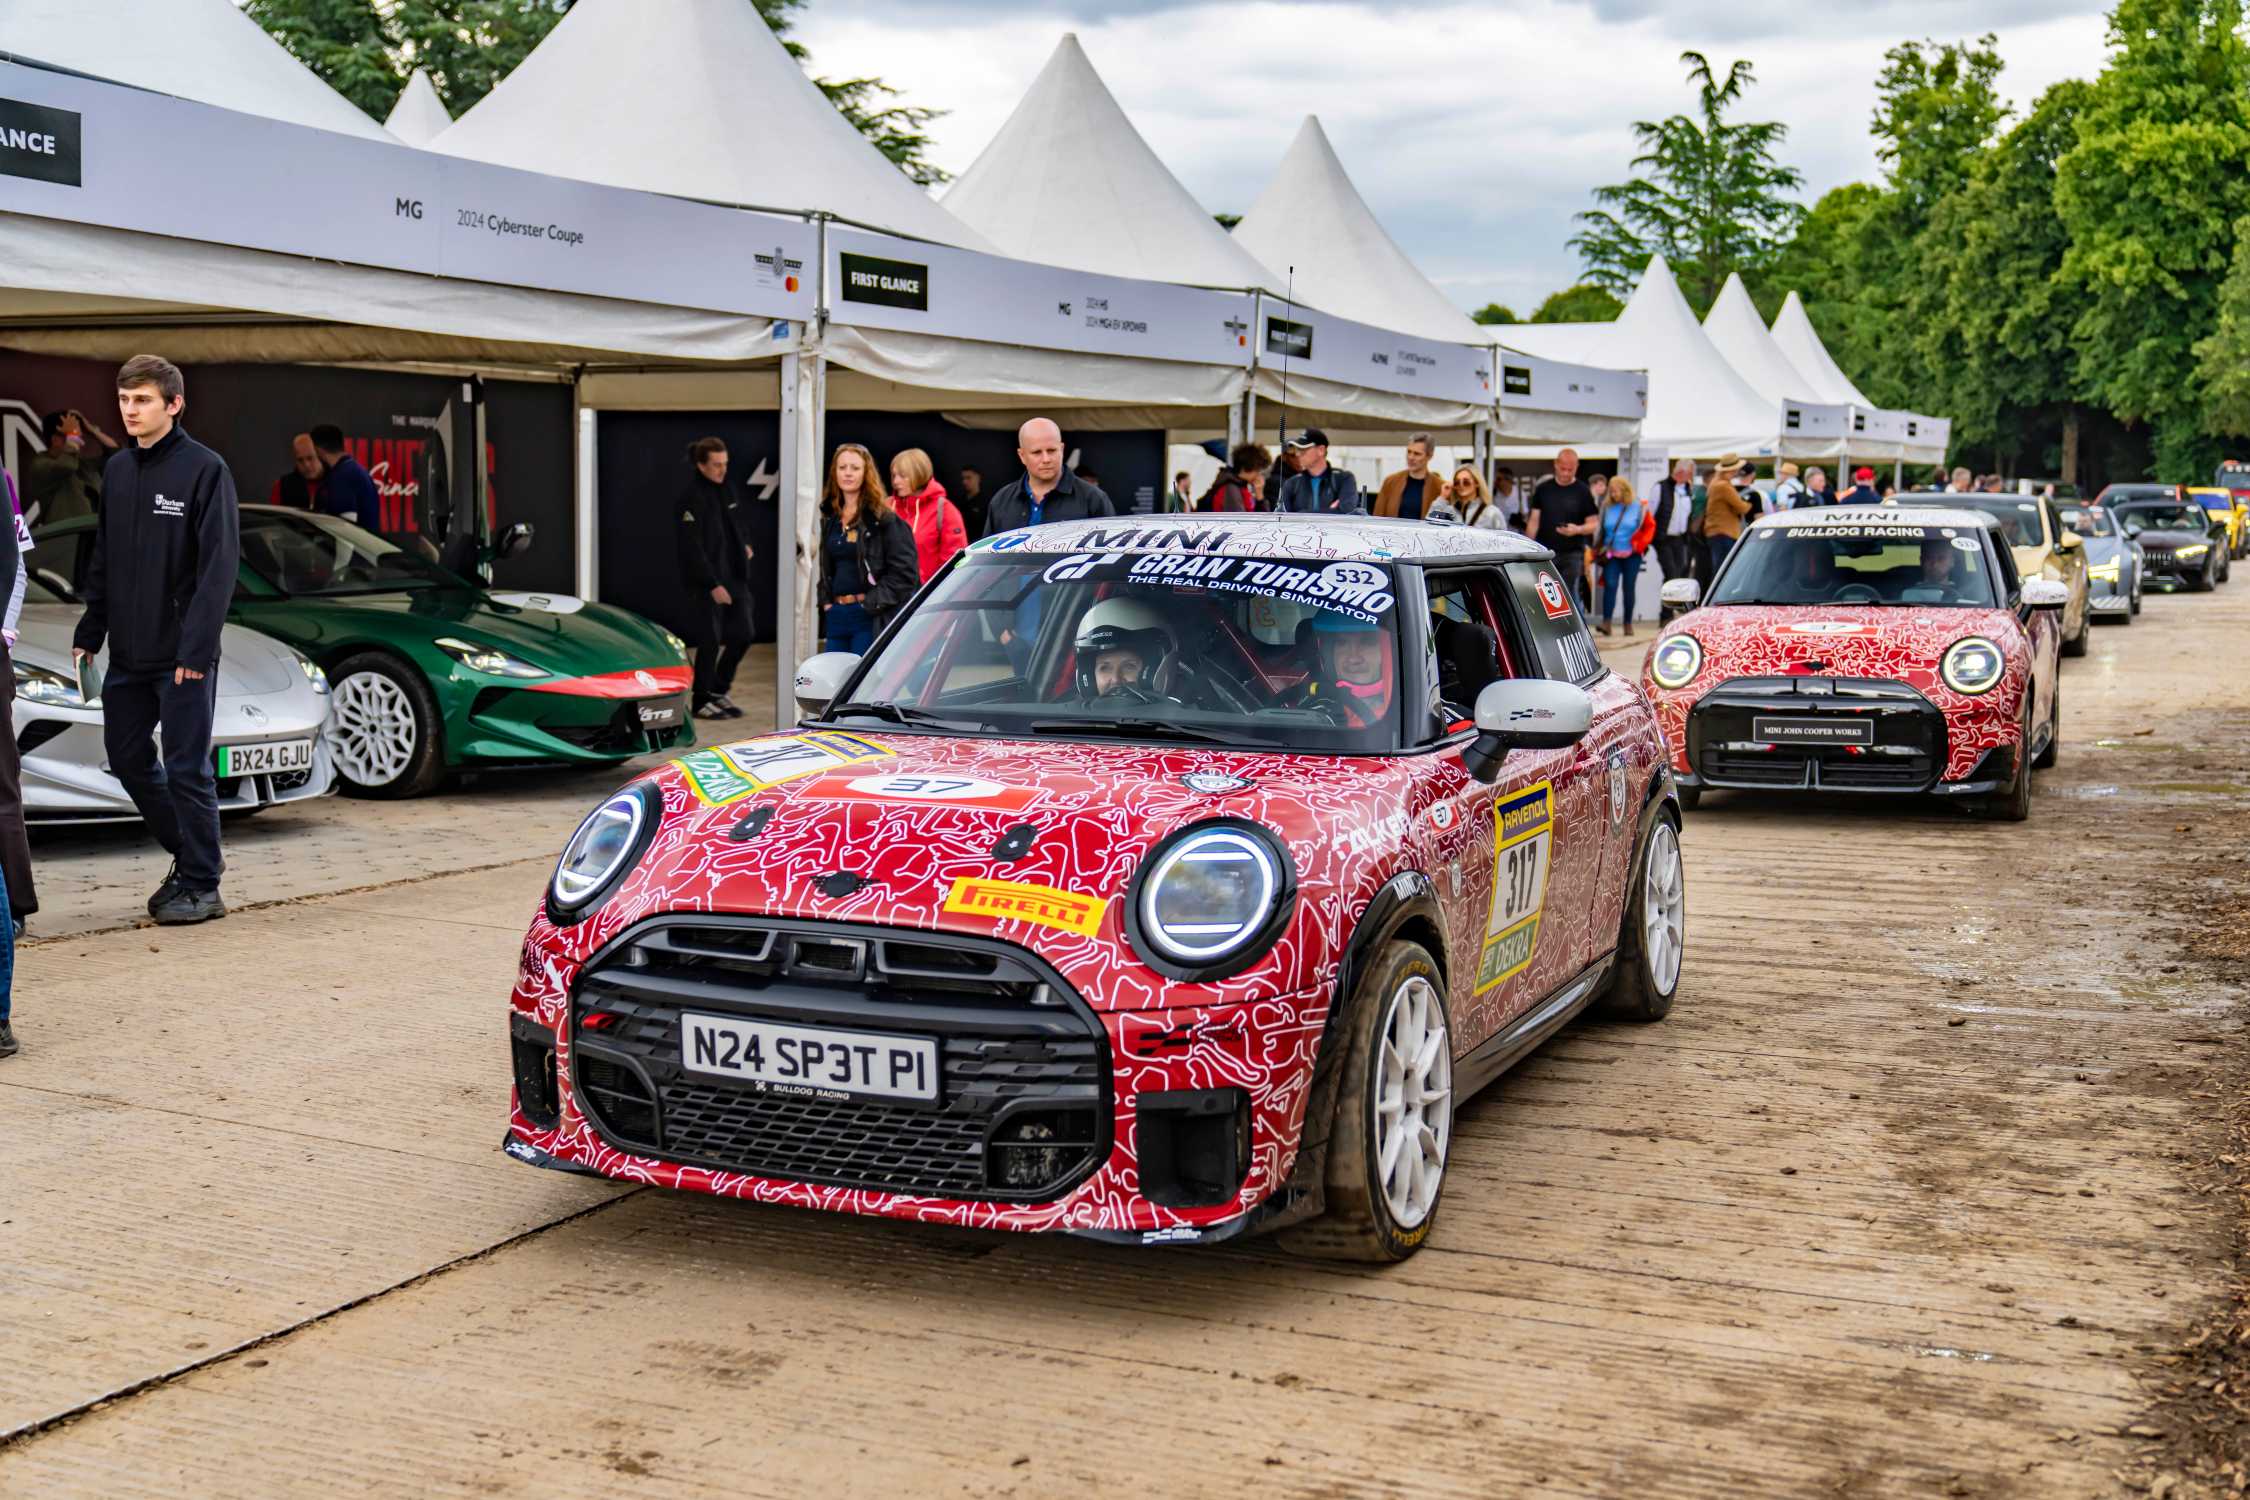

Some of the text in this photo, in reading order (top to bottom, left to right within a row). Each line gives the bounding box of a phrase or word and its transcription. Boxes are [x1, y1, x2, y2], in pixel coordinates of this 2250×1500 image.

[396, 197, 423, 219] MG
[457, 208, 584, 247] 2024 Cyberster Coupe
[851, 271, 919, 293] FIRST GLANCE
[1058, 301, 1071, 316] MG
[1824, 512, 1901, 522] MINI
[1076, 529, 1233, 551] MINI
[1787, 527, 1925, 538] BULLDOG RACING
[1130, 553, 1395, 613] GRAN TURISMO
[1335, 568, 1375, 586] 532
[1127, 575, 1378, 625] THE REAL DRIVING SIMULATOR
[1783, 727, 1803, 735] JOHN
[1835, 728, 1862, 736] WORKS
[231, 744, 309, 772] BX24 GJU
[881, 778, 974, 793] 37
[1436, 806, 1448, 824] 37
[1505, 800, 1546, 829] RAVENOL
[1505, 840, 1537, 919] 317
[960, 884, 1091, 926] PIRELLI
[1495, 926, 1530, 975] DEKRA
[694, 1026, 765, 1073] N24
[775, 1037, 877, 1086] SP3T
[773, 1084, 850, 1101] BULLDOG RACING
